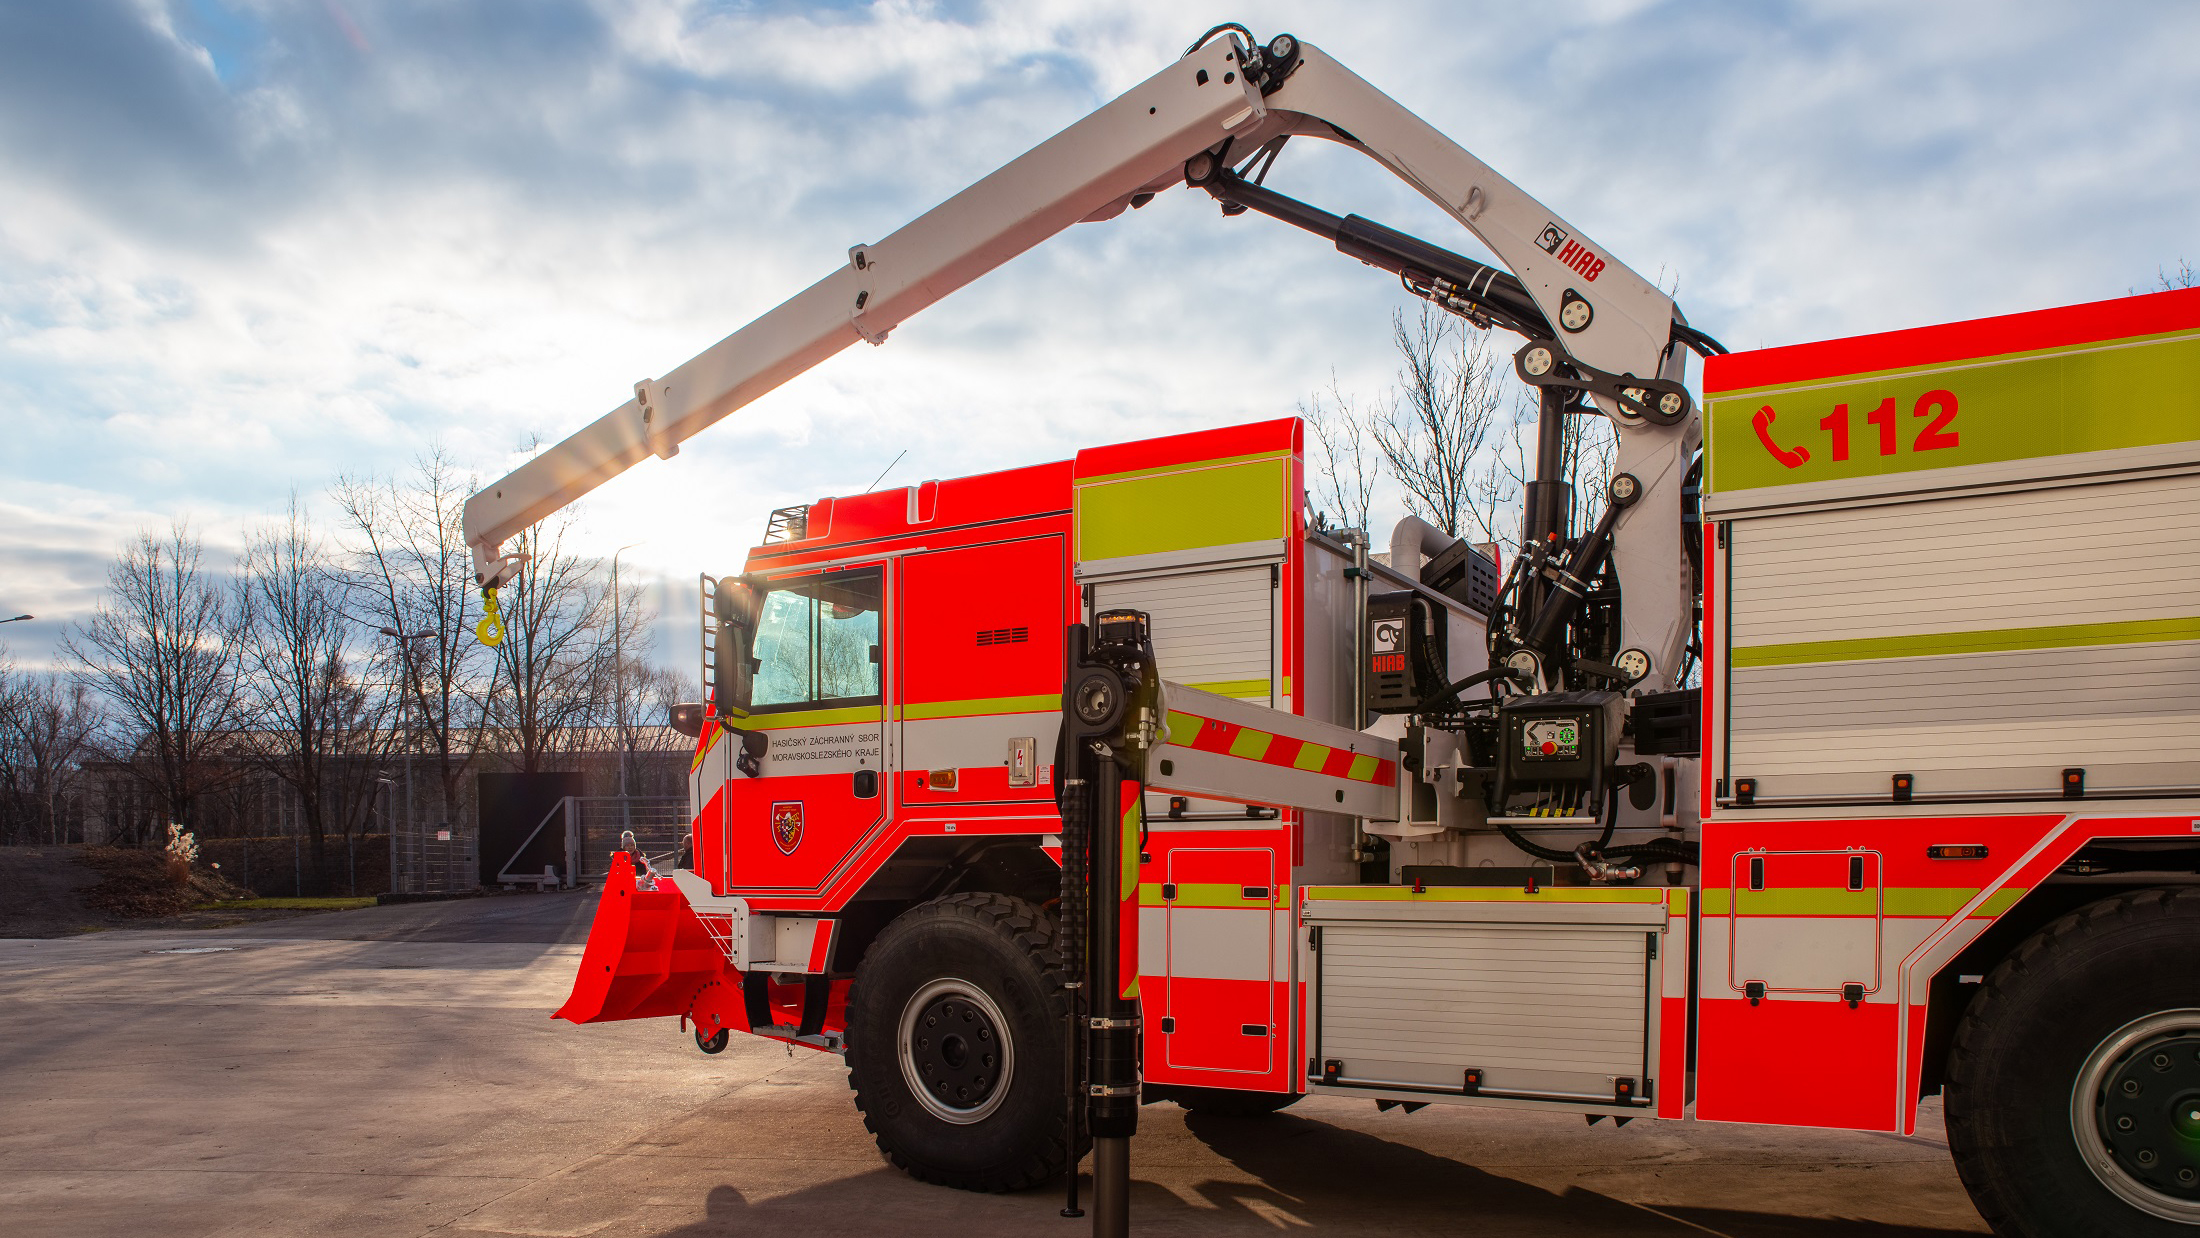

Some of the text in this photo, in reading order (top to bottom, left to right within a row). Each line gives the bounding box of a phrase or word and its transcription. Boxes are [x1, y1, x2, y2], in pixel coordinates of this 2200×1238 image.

[1557, 239, 1606, 282] HIAB
[1820, 389, 1960, 462] 112
[1372, 654, 1405, 673] HIAB
[772, 733, 879, 747] HASIČSKÝ ZÁCHRANNÝ SBOR
[772, 747, 879, 761] MORAVSKOSLEZSKÉHO KRAJE
